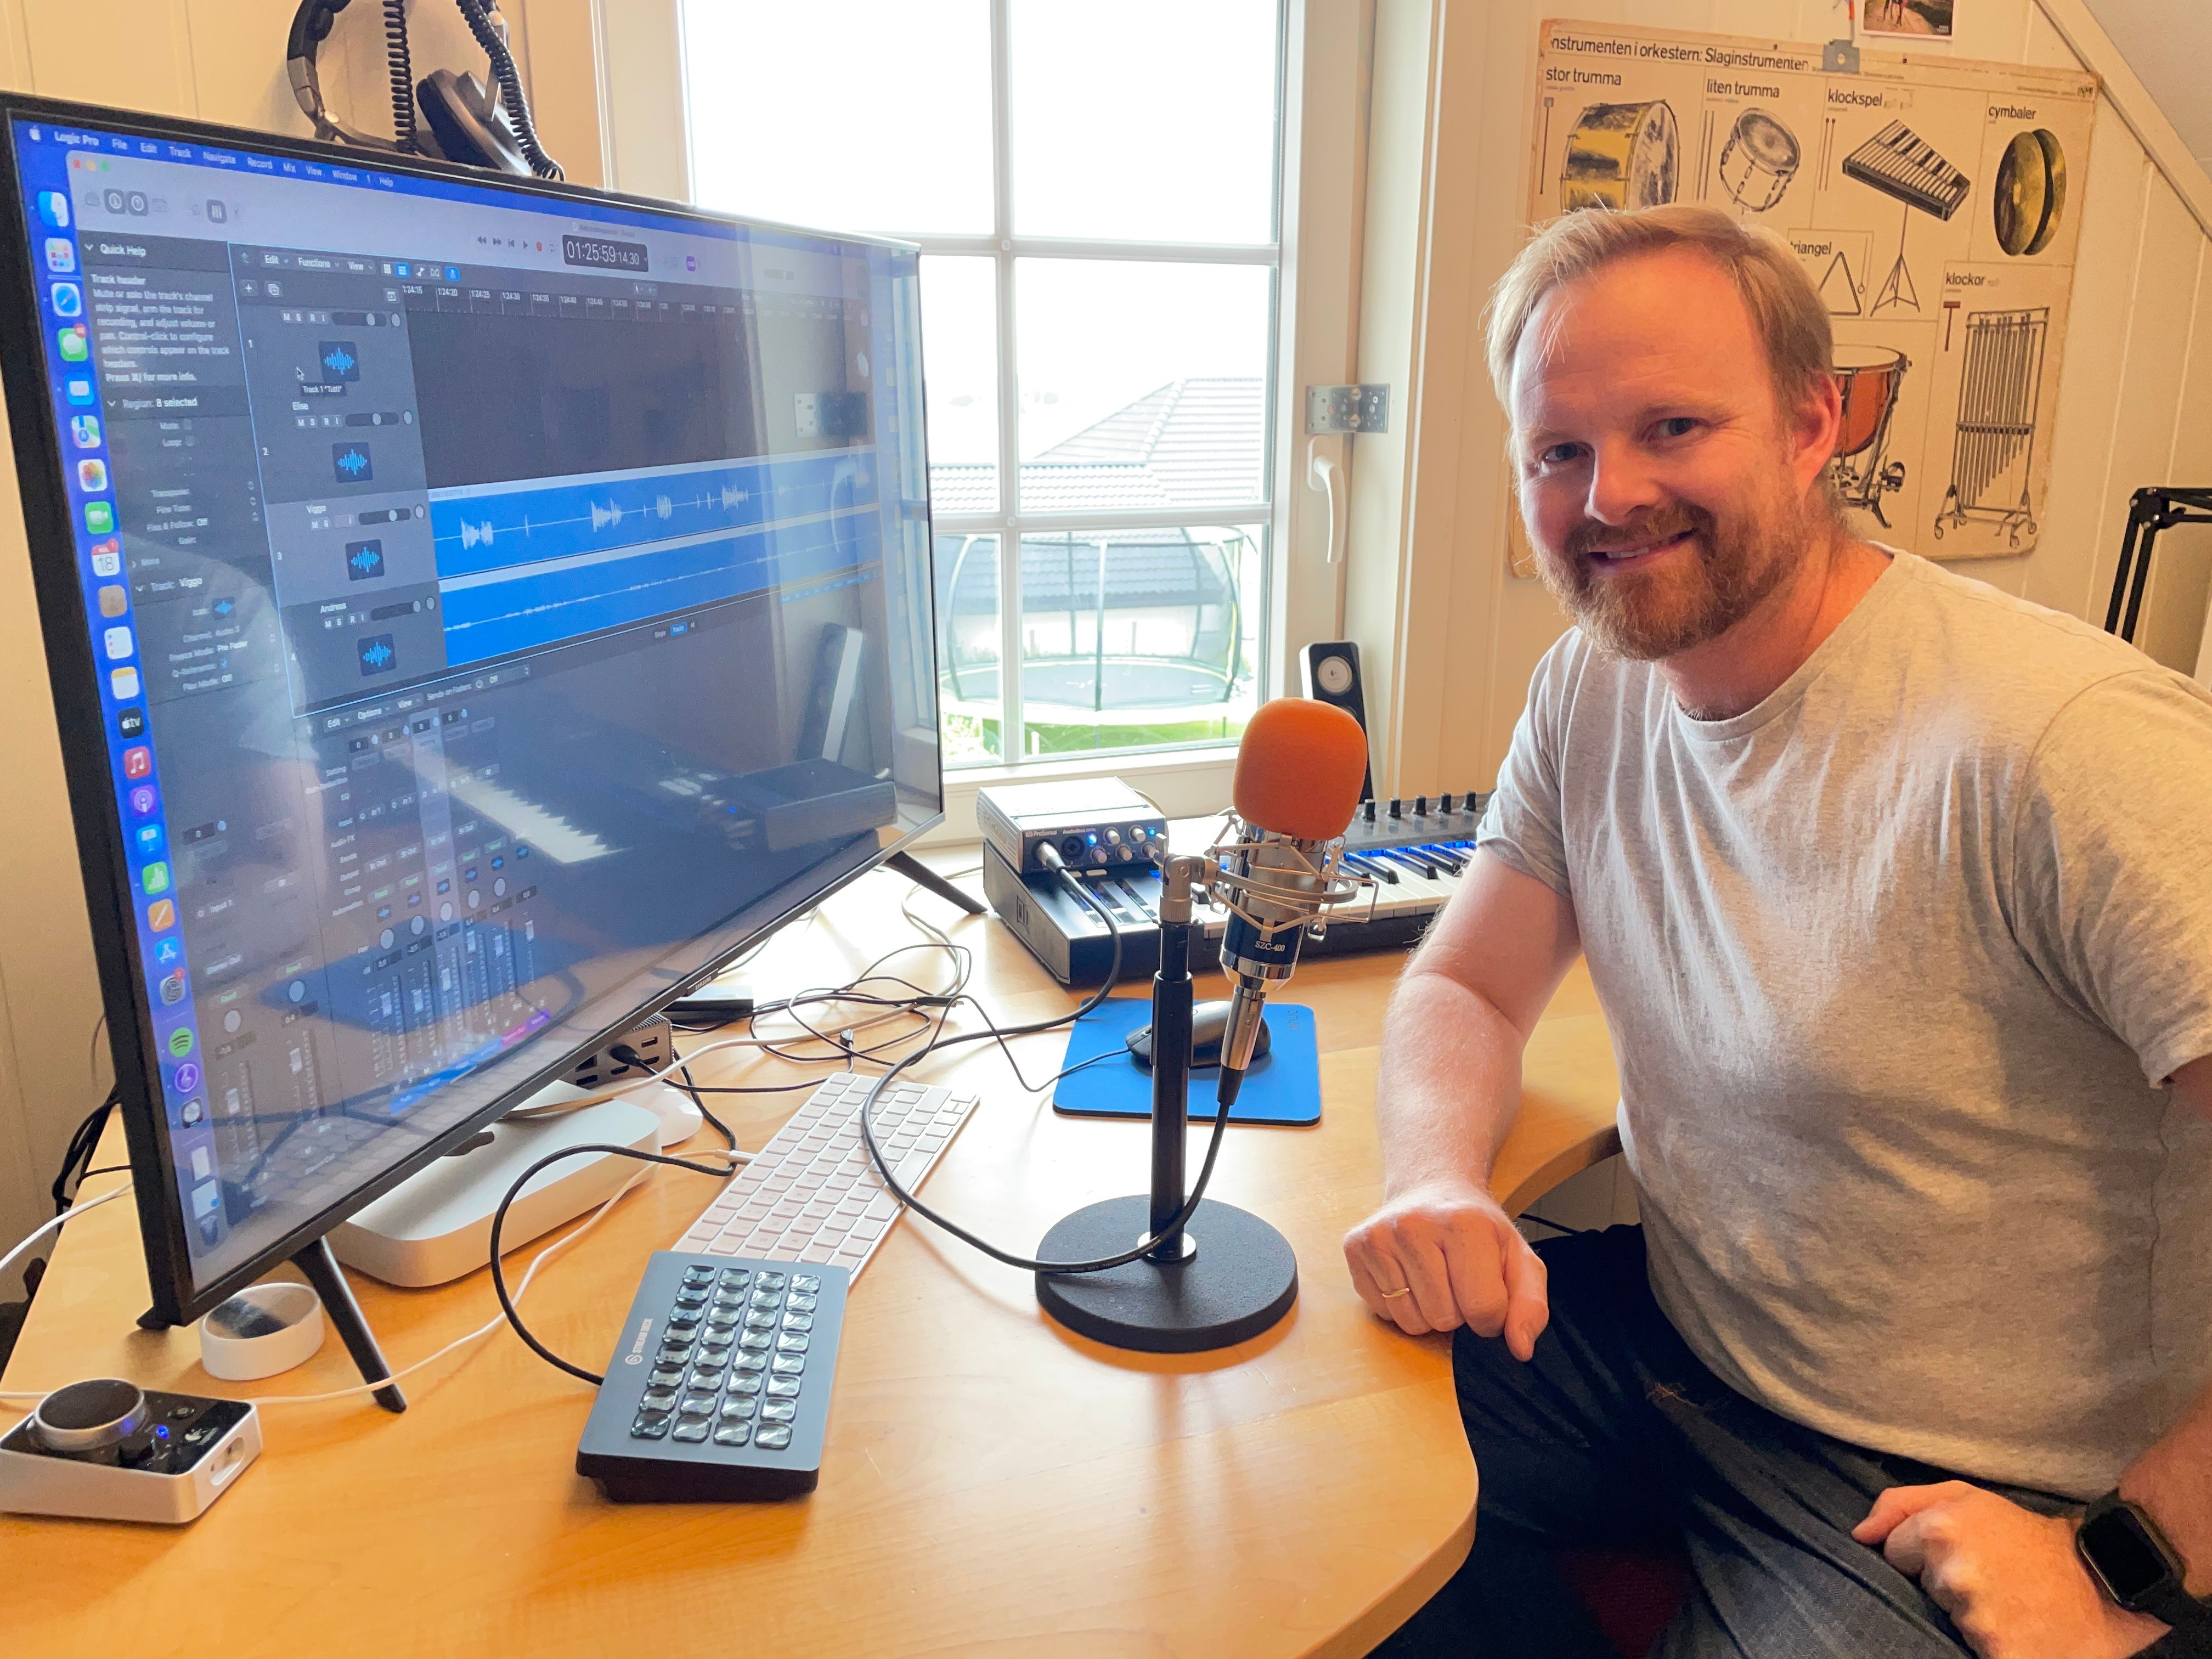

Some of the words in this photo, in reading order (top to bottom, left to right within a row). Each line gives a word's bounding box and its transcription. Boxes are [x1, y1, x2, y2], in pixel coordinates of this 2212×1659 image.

[1551, 35, 1632, 55] nstrumenten
[1634, 42, 1638, 55] i
[1546, 66, 1571, 82] stor
[1573, 67, 1622, 86] trumma
[1706, 78, 1732, 94] liten
[1735, 81, 1780, 98] trumma
[1827, 88, 1883, 108] klockspel
[1988, 105, 2036, 120] cymbaler
[82, 134, 99, 146] Pro
[112, 138, 128, 150] File
[140, 142, 157, 153] Edit
[168, 146, 191, 159] Track
[202, 151, 236, 165] Navigate
[247, 157, 273, 170] Record
[283, 163, 296, 173] Mix
[306, 166, 322, 177] View
[332, 170, 358, 181] Window
[379, 177, 393, 188] Help
[100, 244, 125, 255] Quick
[127, 246, 146, 257] Help
[348, 262, 363, 270] View
[1945, 272, 1985, 286] klockor
[98, 556, 114, 571] 18
[320, 602, 347, 613] Andreas
[1255, 940, 1285, 952] SZC-400
